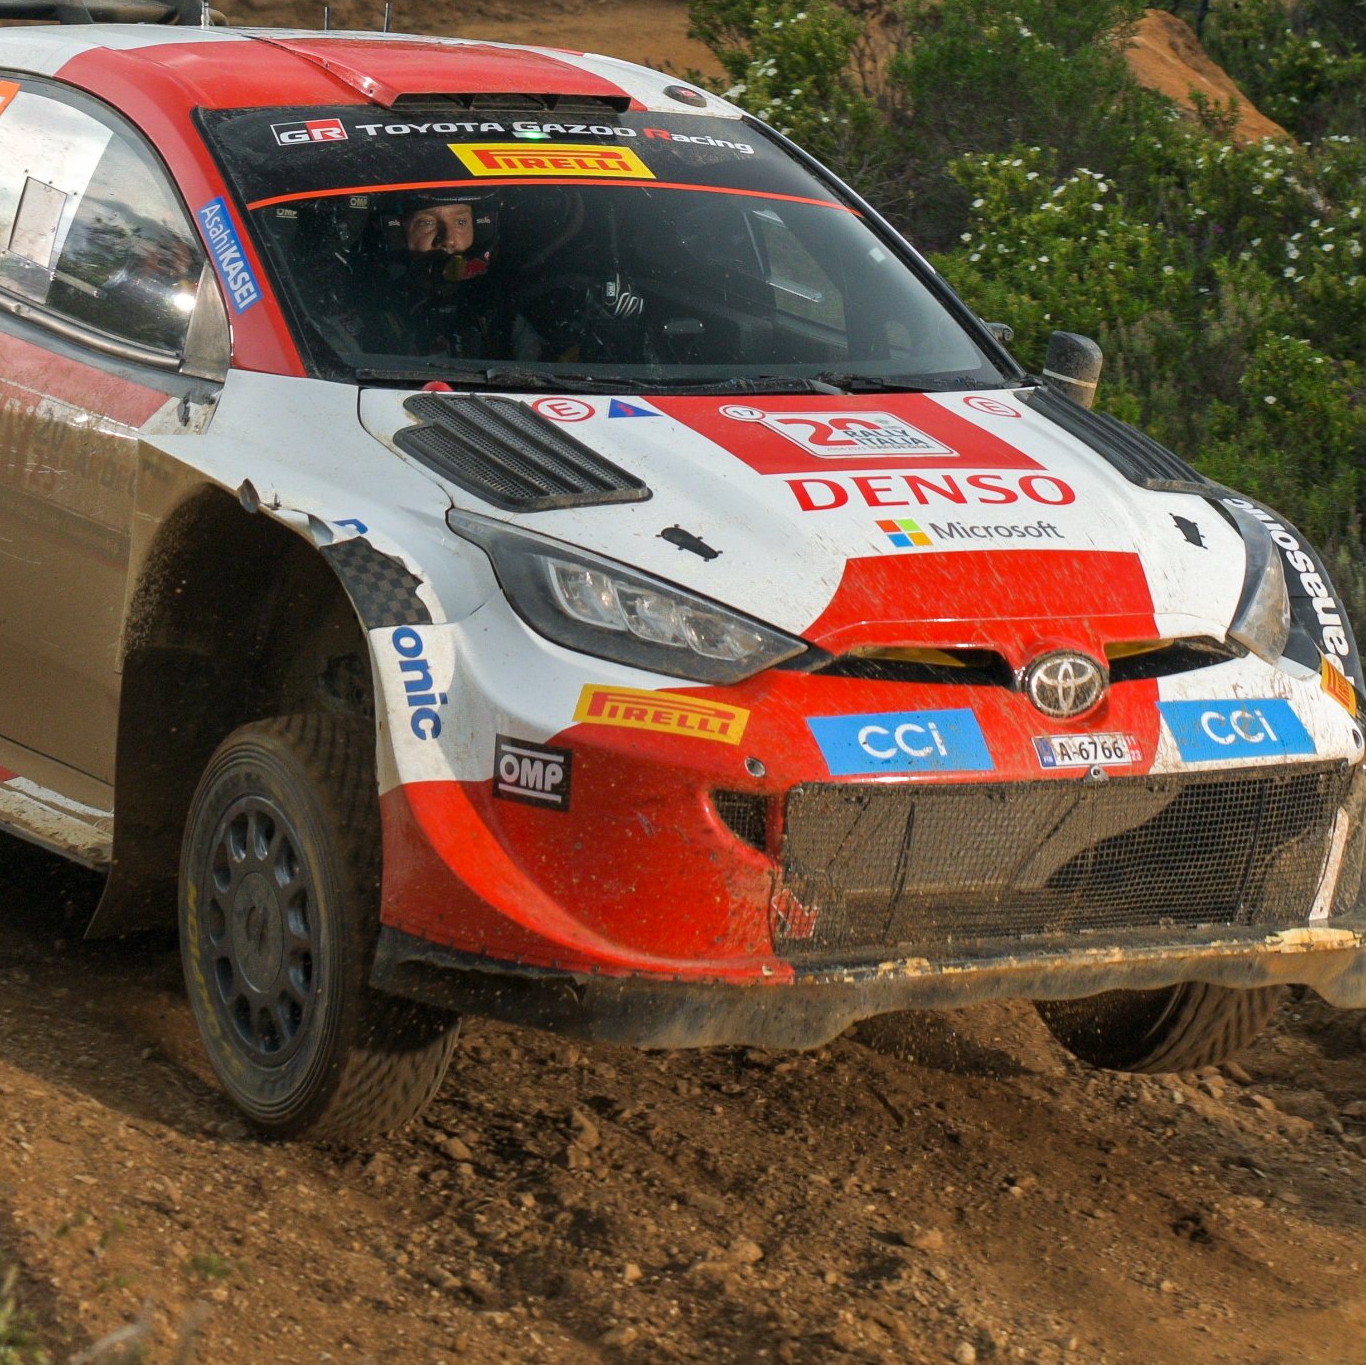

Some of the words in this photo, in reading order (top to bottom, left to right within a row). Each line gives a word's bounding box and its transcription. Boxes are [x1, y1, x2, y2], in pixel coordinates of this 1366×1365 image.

[355, 122, 506, 137] TOYOTA
[511, 121, 638, 138] GAZOO
[642, 126, 756, 155] Racing
[471, 147, 634, 173] PIRELLI
[841, 429, 912, 439] RALLY
[852, 437, 929, 447] ITALIA
[784, 474, 1076, 512] DENSO
[928, 520, 1065, 540] Microsoft
[587, 690, 737, 735] PIRELLI
[1058, 741, 1124, 762] A-6766
[499, 753, 564, 793] OMP
